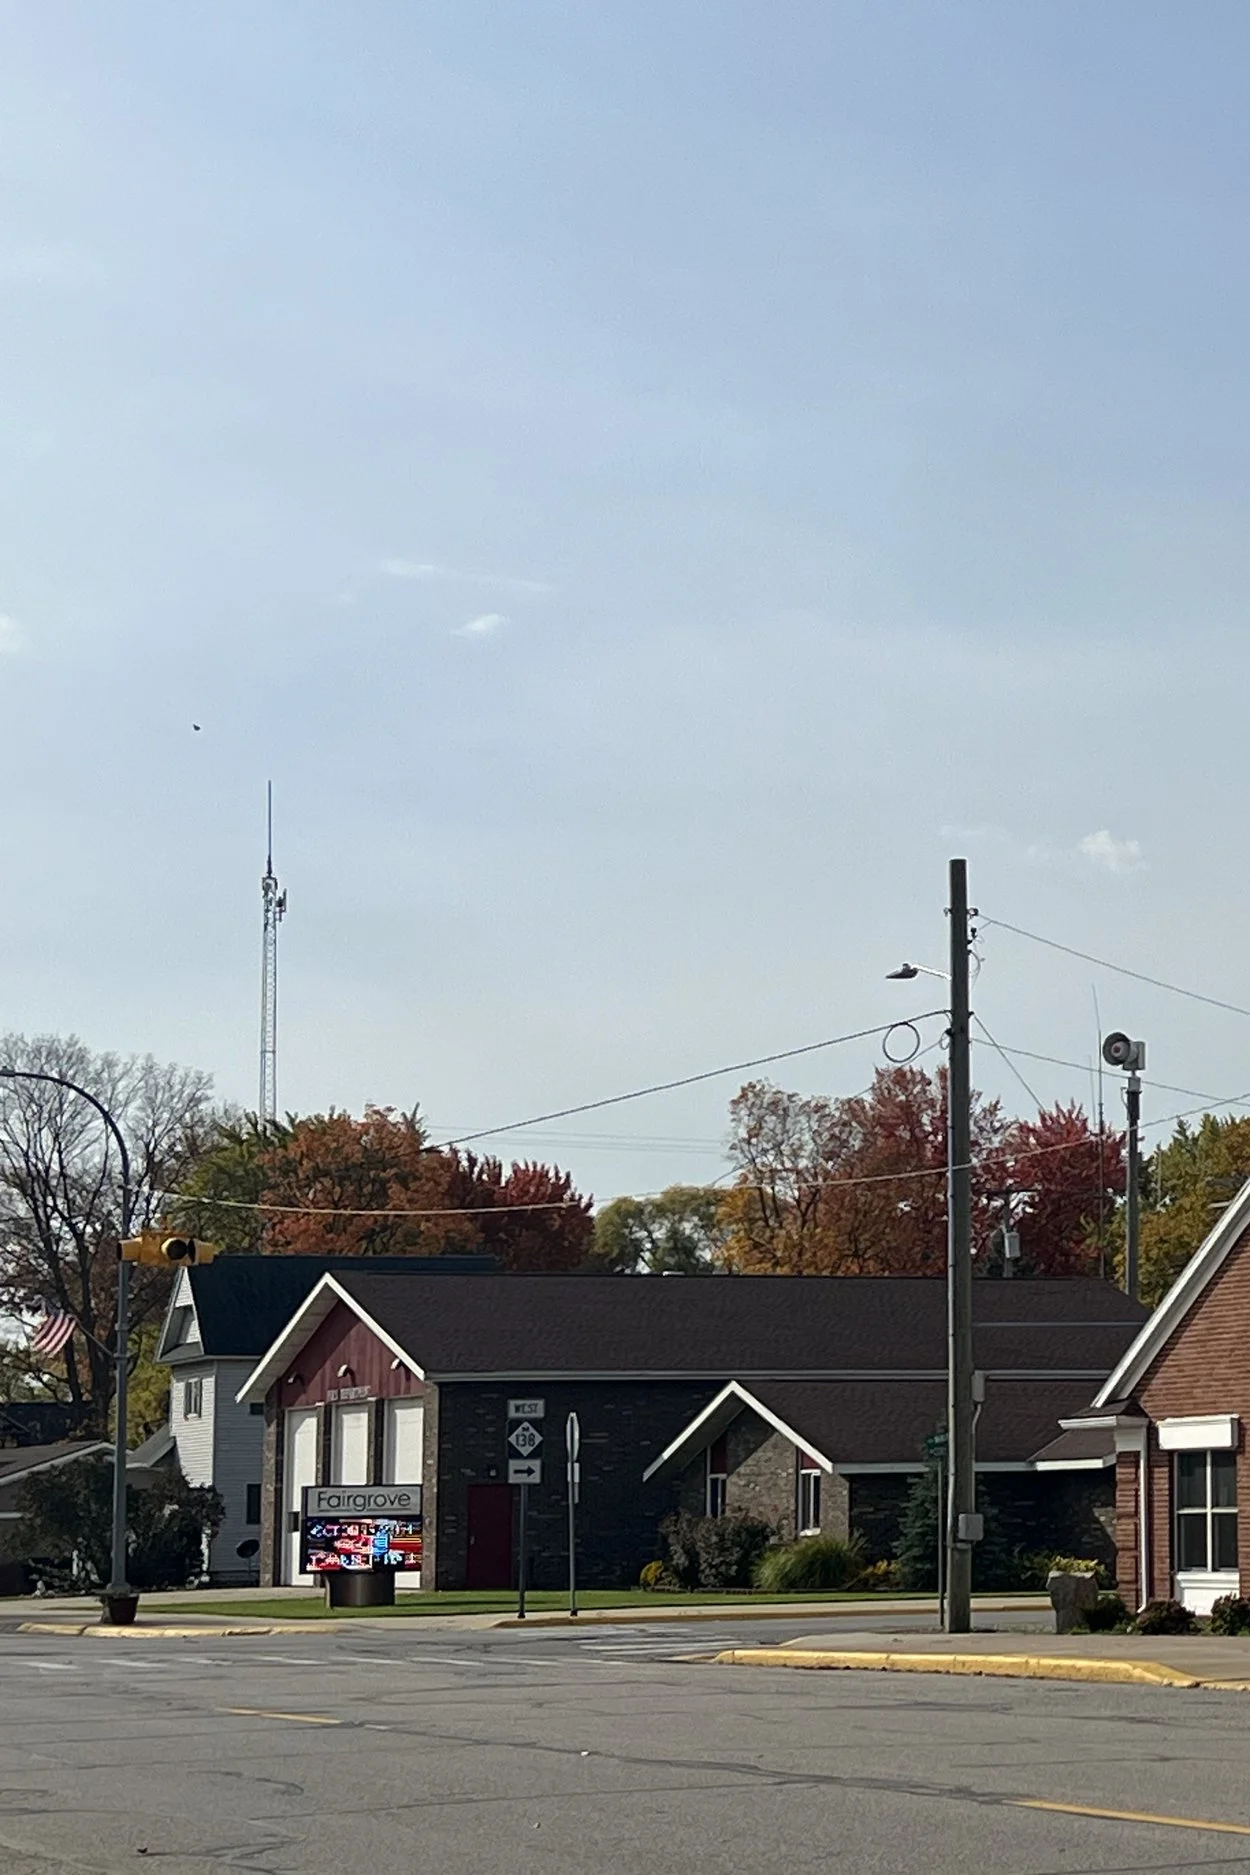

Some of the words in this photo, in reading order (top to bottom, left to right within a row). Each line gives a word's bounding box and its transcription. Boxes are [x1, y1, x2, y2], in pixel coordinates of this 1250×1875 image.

[513, 1402, 539, 1414] WEST
[515, 1433, 536, 1448] 138
[317, 1490, 411, 1512] Fairgrove
